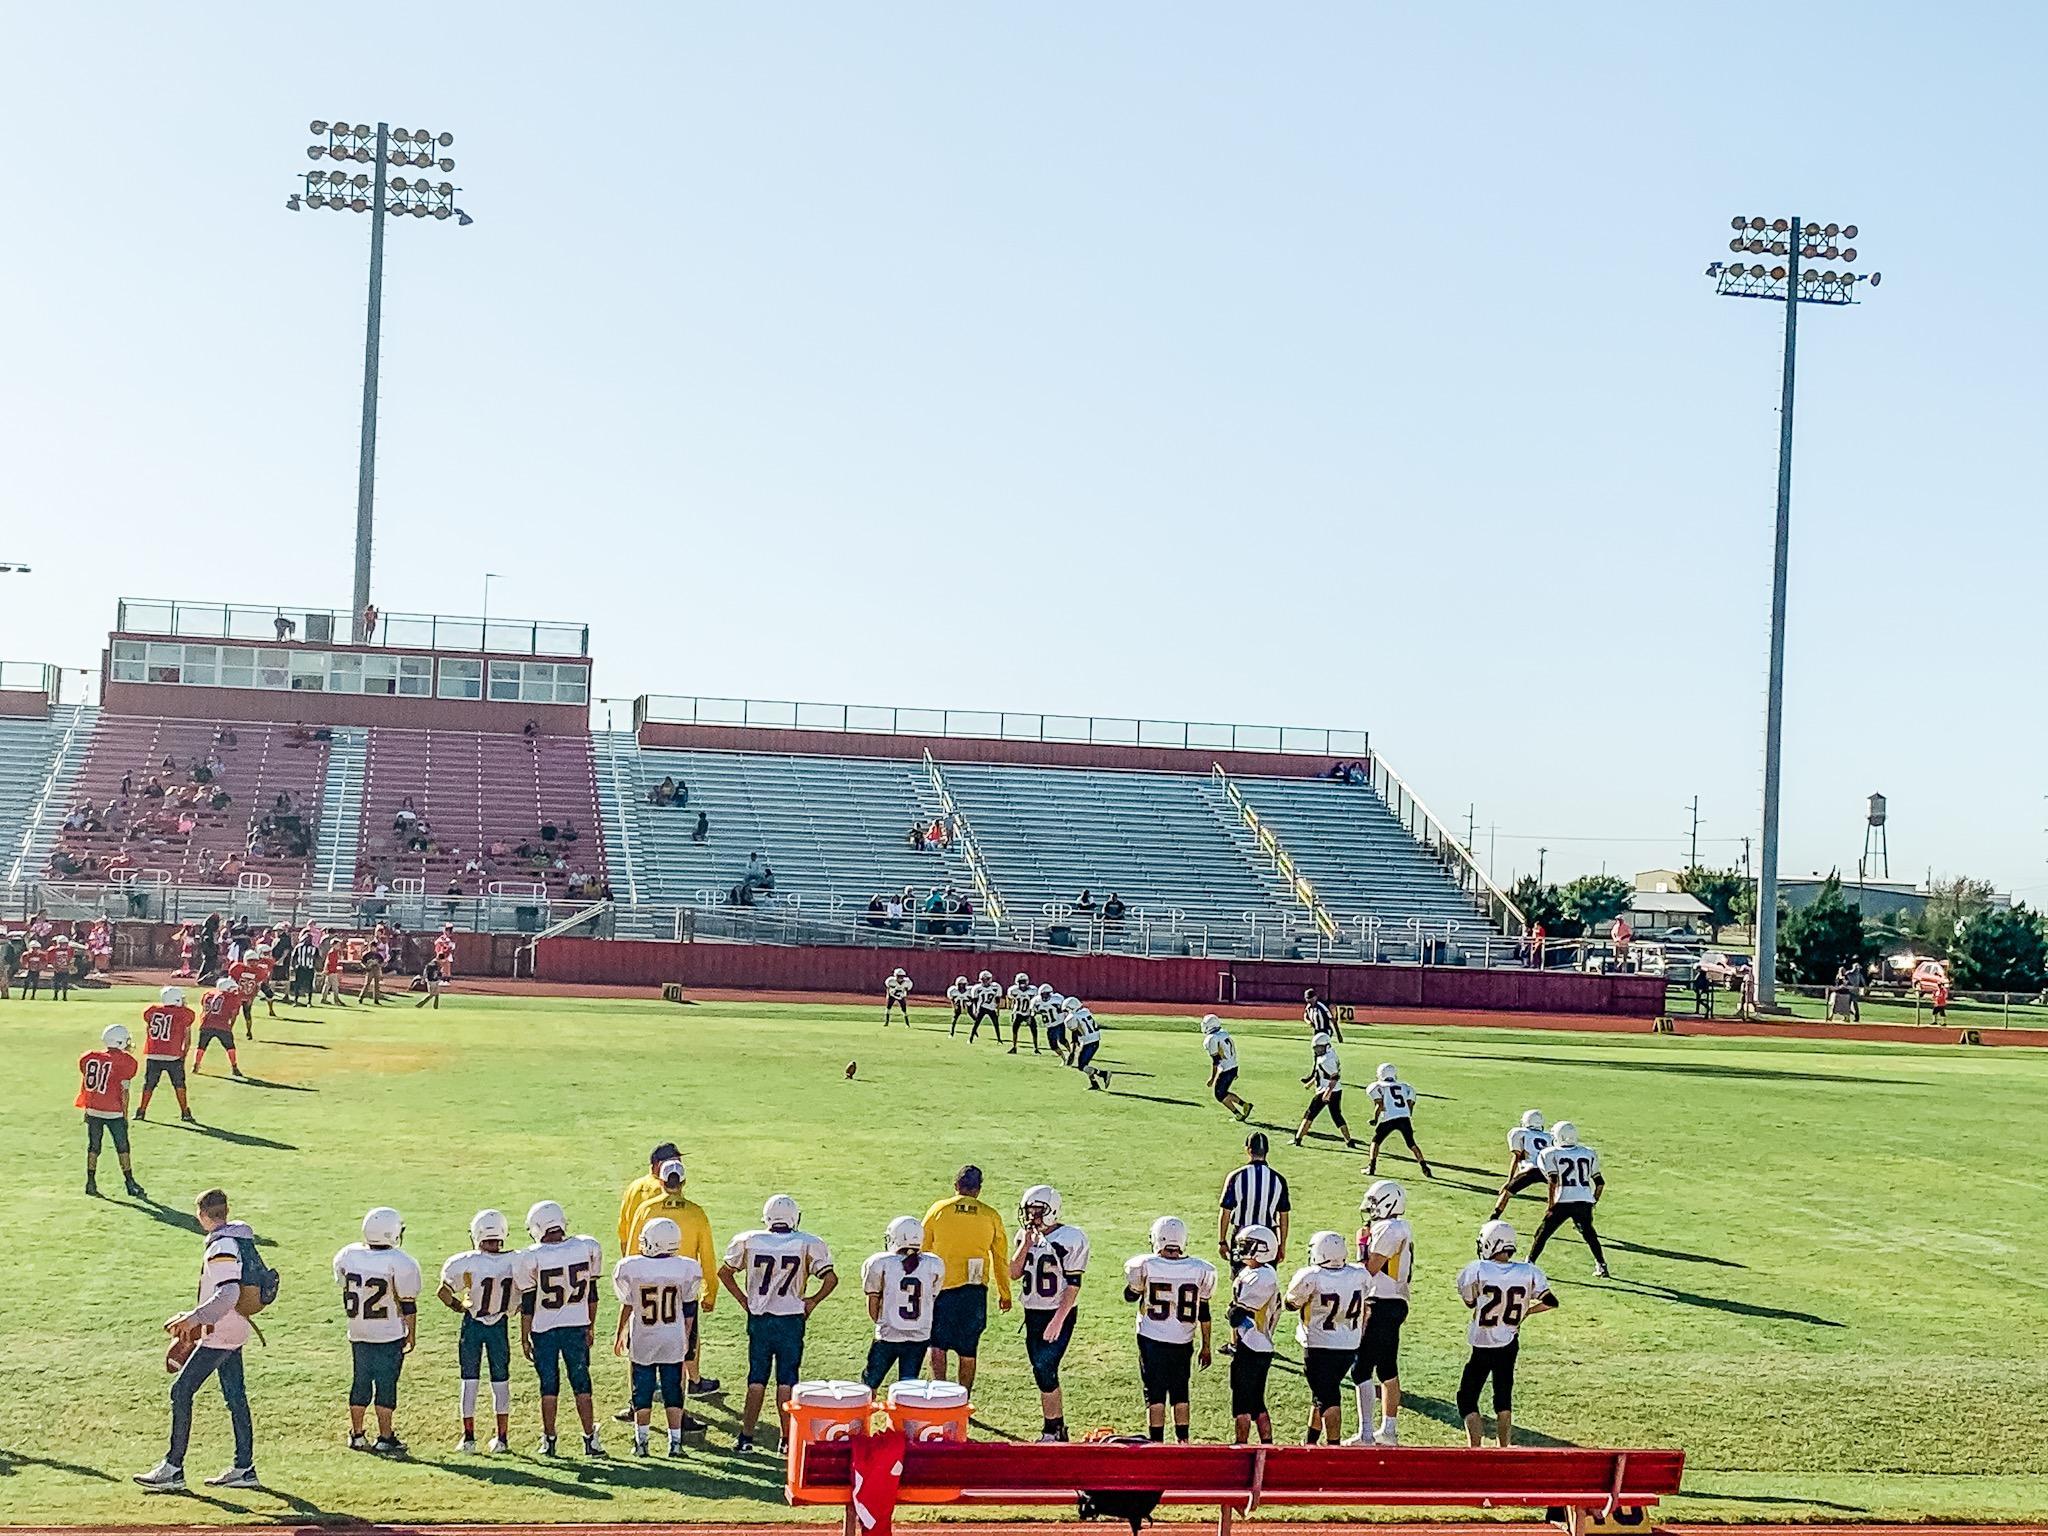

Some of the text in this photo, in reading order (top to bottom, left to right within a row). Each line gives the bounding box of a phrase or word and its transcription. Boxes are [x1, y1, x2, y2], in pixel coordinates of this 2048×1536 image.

[1016, 998, 1029, 1012] 10
[1340, 1006, 1354, 1020] 20
[150, 1012, 173, 1041] 51
[1968, 1030, 1980, 1044] G
[84, 1058, 112, 1095] 81
[1390, 1085, 1406, 1109] 5
[1559, 1157, 1590, 1187] 20
[344, 1272, 389, 1320] 62
[540, 1261, 590, 1310] 55
[754, 1254, 801, 1297] 77
[476, 1276, 512, 1318] 11
[640, 1285, 678, 1326] 50
[898, 1276, 922, 1321] 3
[1149, 1281, 1199, 1323] 58
[1478, 1285, 1527, 1327] 26
